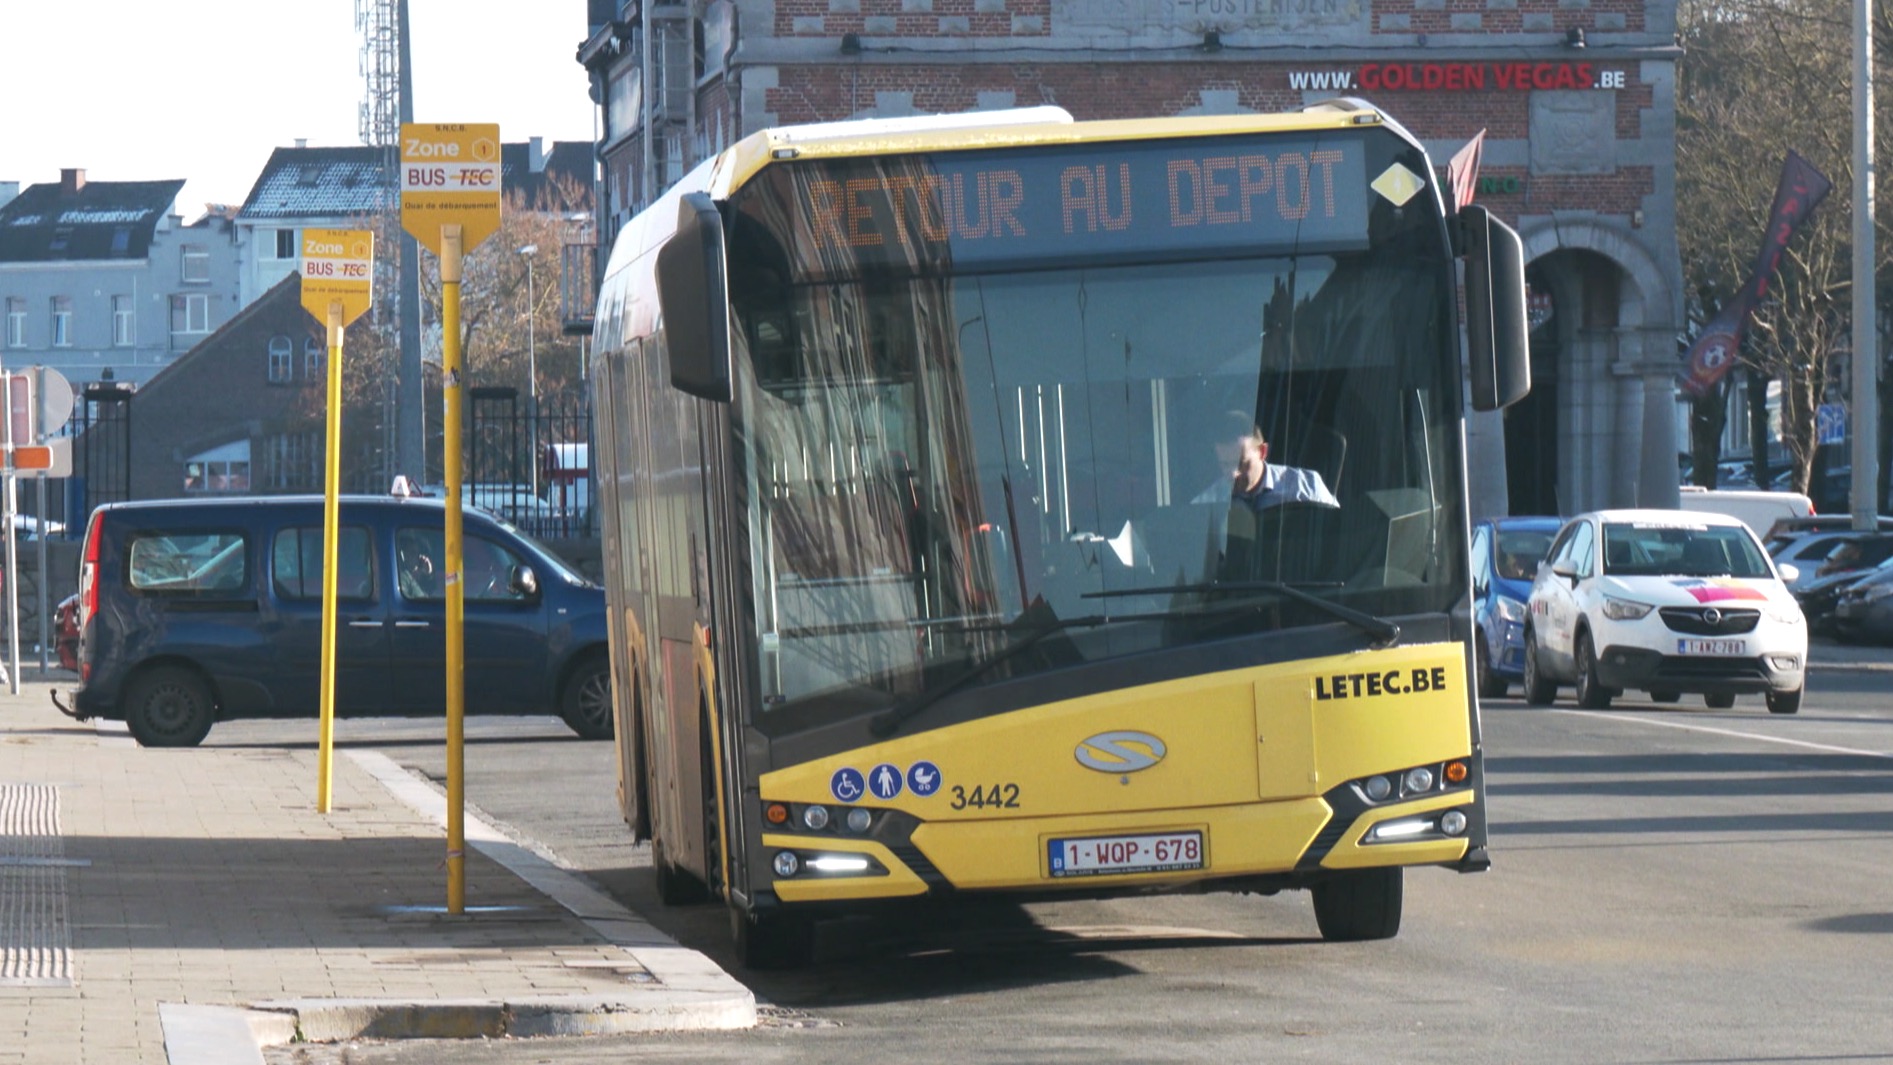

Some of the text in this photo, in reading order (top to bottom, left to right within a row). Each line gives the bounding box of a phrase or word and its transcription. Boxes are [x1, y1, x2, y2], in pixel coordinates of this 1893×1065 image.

[1493, 63, 1625, 90] VEGAS.BE
[405, 138, 459, 157] Zone
[408, 168, 494, 186] BUS TEC
[811, 149, 1344, 248] RETOUR AU DEPOT
[306, 240, 344, 255] Zone
[307, 262, 367, 277] BUS TEC
[1315, 667, 1446, 701] LETEC.BE
[950, 783, 1020, 810] 3442
[1069, 839, 1198, 866] 1-WQP-678
